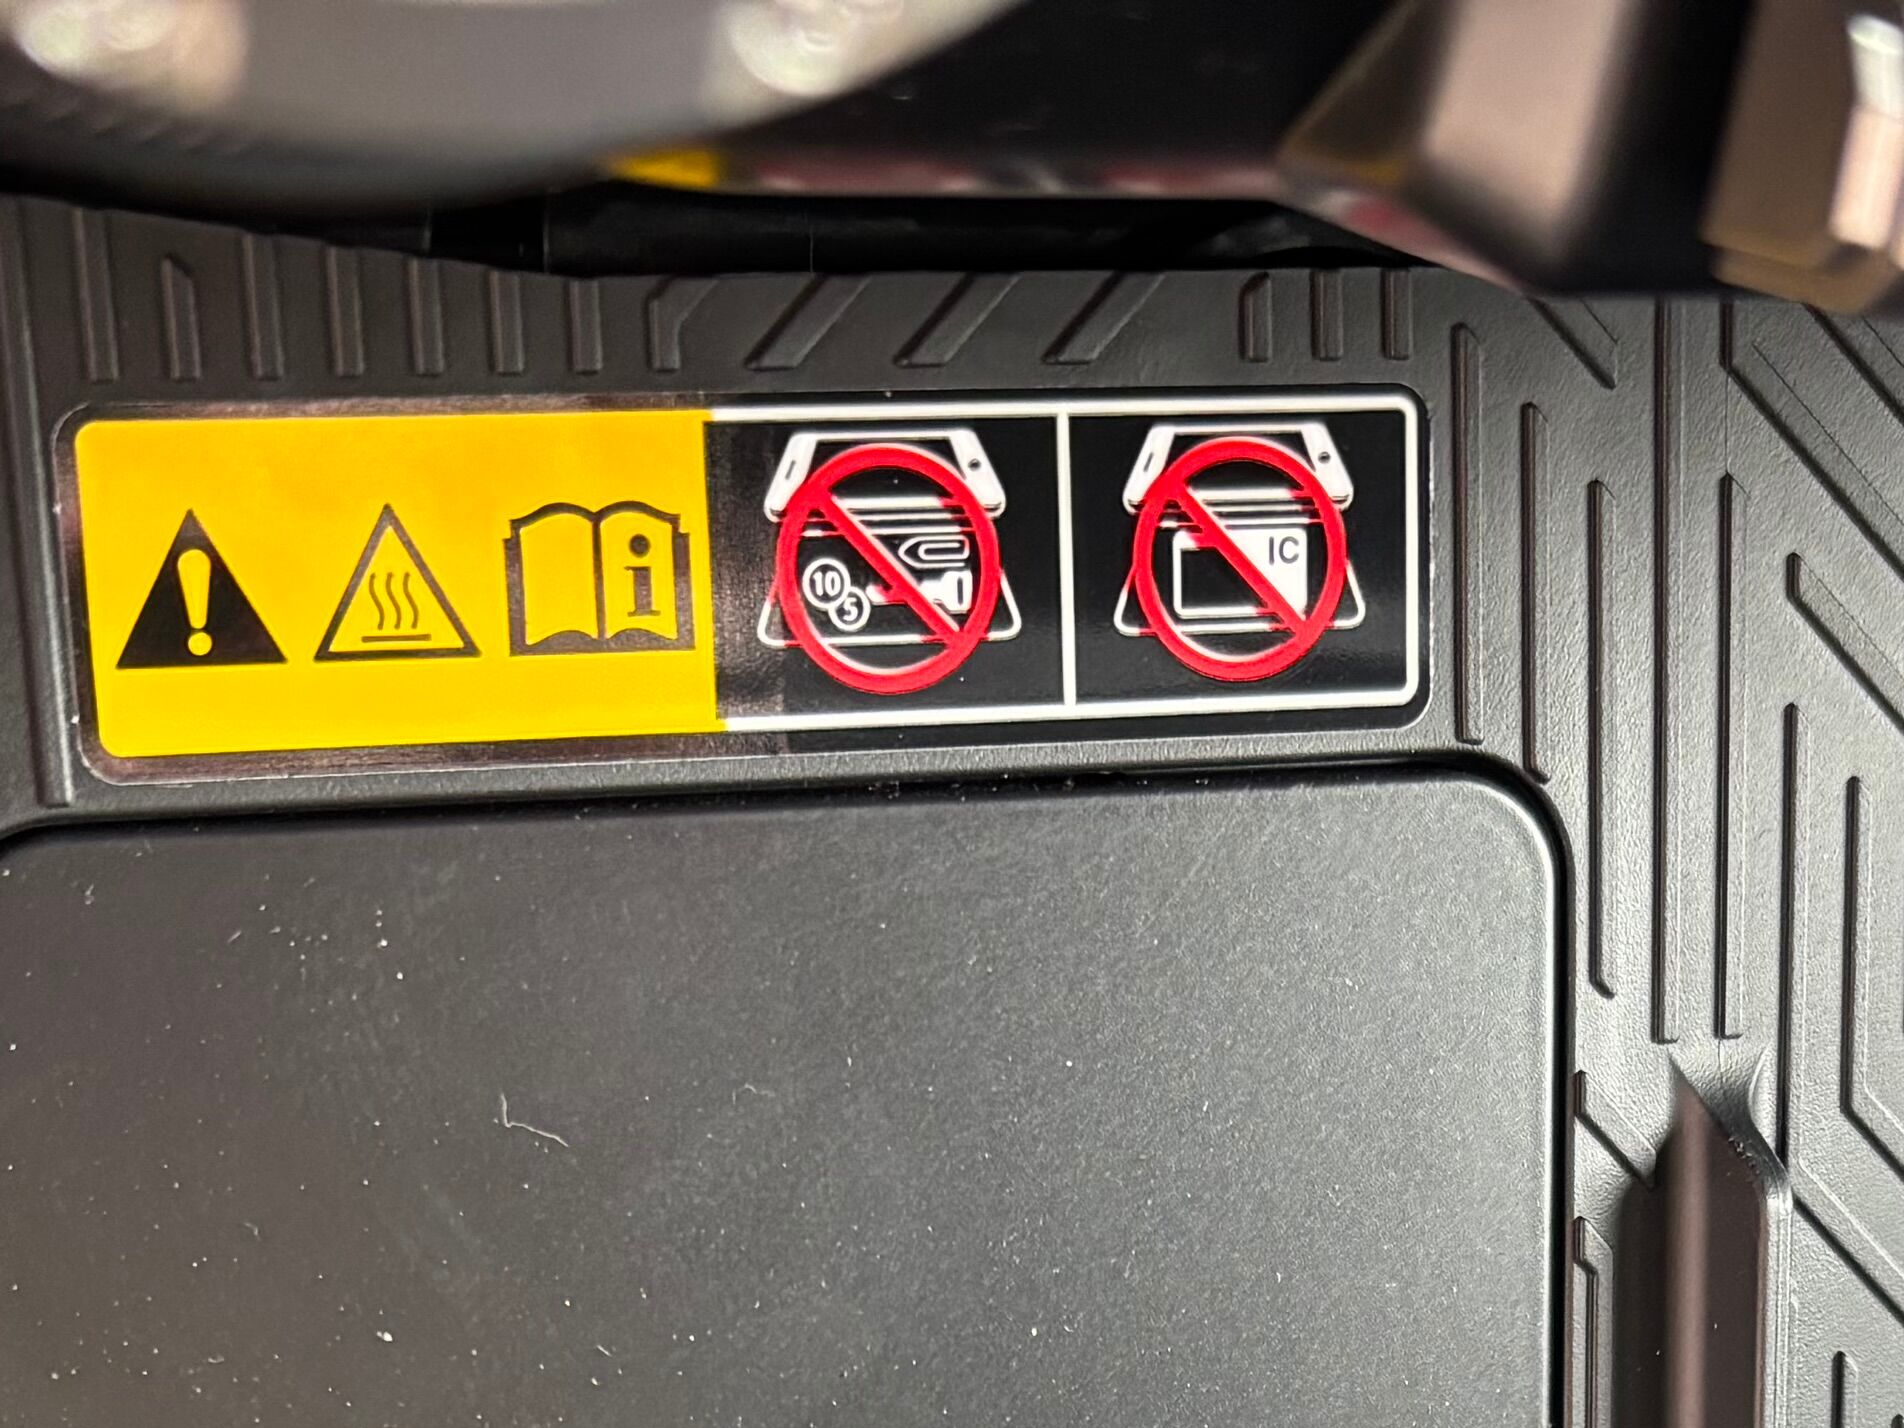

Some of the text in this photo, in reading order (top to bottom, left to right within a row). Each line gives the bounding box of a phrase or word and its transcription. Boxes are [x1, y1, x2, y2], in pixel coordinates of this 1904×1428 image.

[1268, 535, 1300, 566] IC
[812, 570, 842, 597] 10
[842, 597, 859, 622] 5
